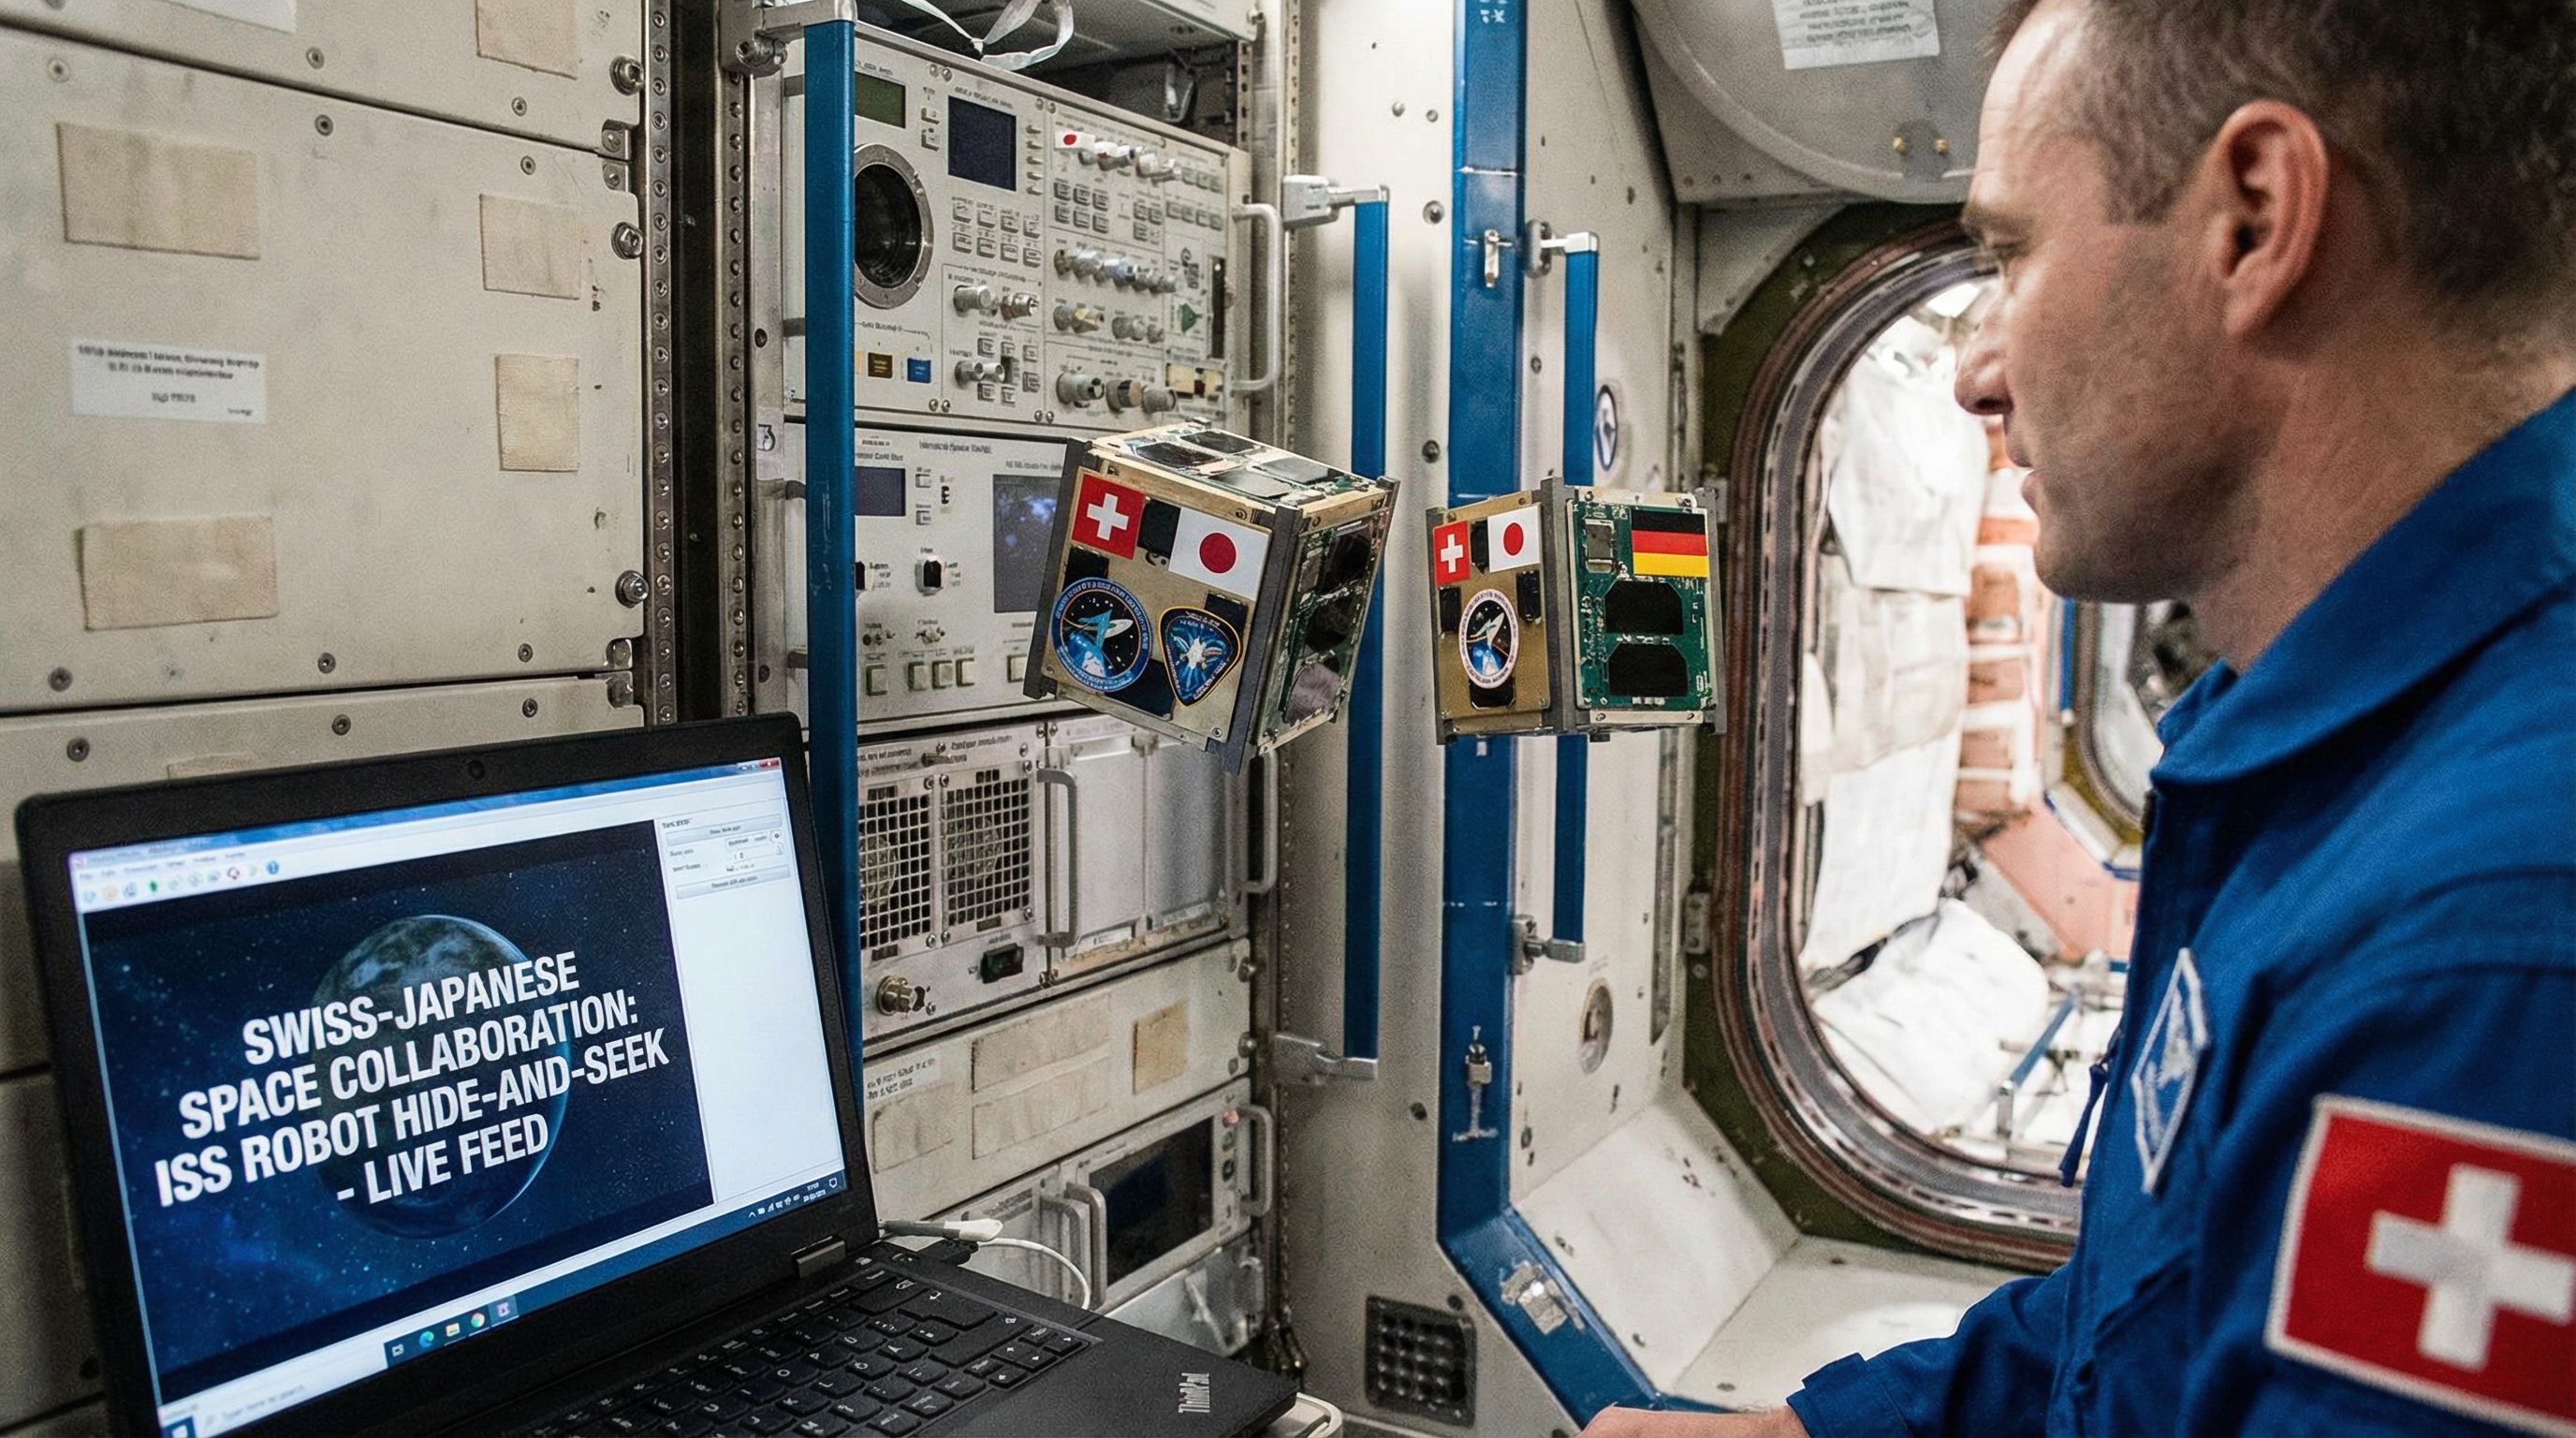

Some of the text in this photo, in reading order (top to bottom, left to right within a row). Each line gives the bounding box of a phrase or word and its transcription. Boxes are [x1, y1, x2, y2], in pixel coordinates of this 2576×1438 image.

[179, 990, 639, 1140] SPACE COLLABORATION:
[242, 950, 580, 1065] SWISS-JAPANESE
[154, 1028, 670, 1207] ISS ROBOT HIDE-AND-SEEK
[337, 1113, 549, 1204] - LIVE FEED
